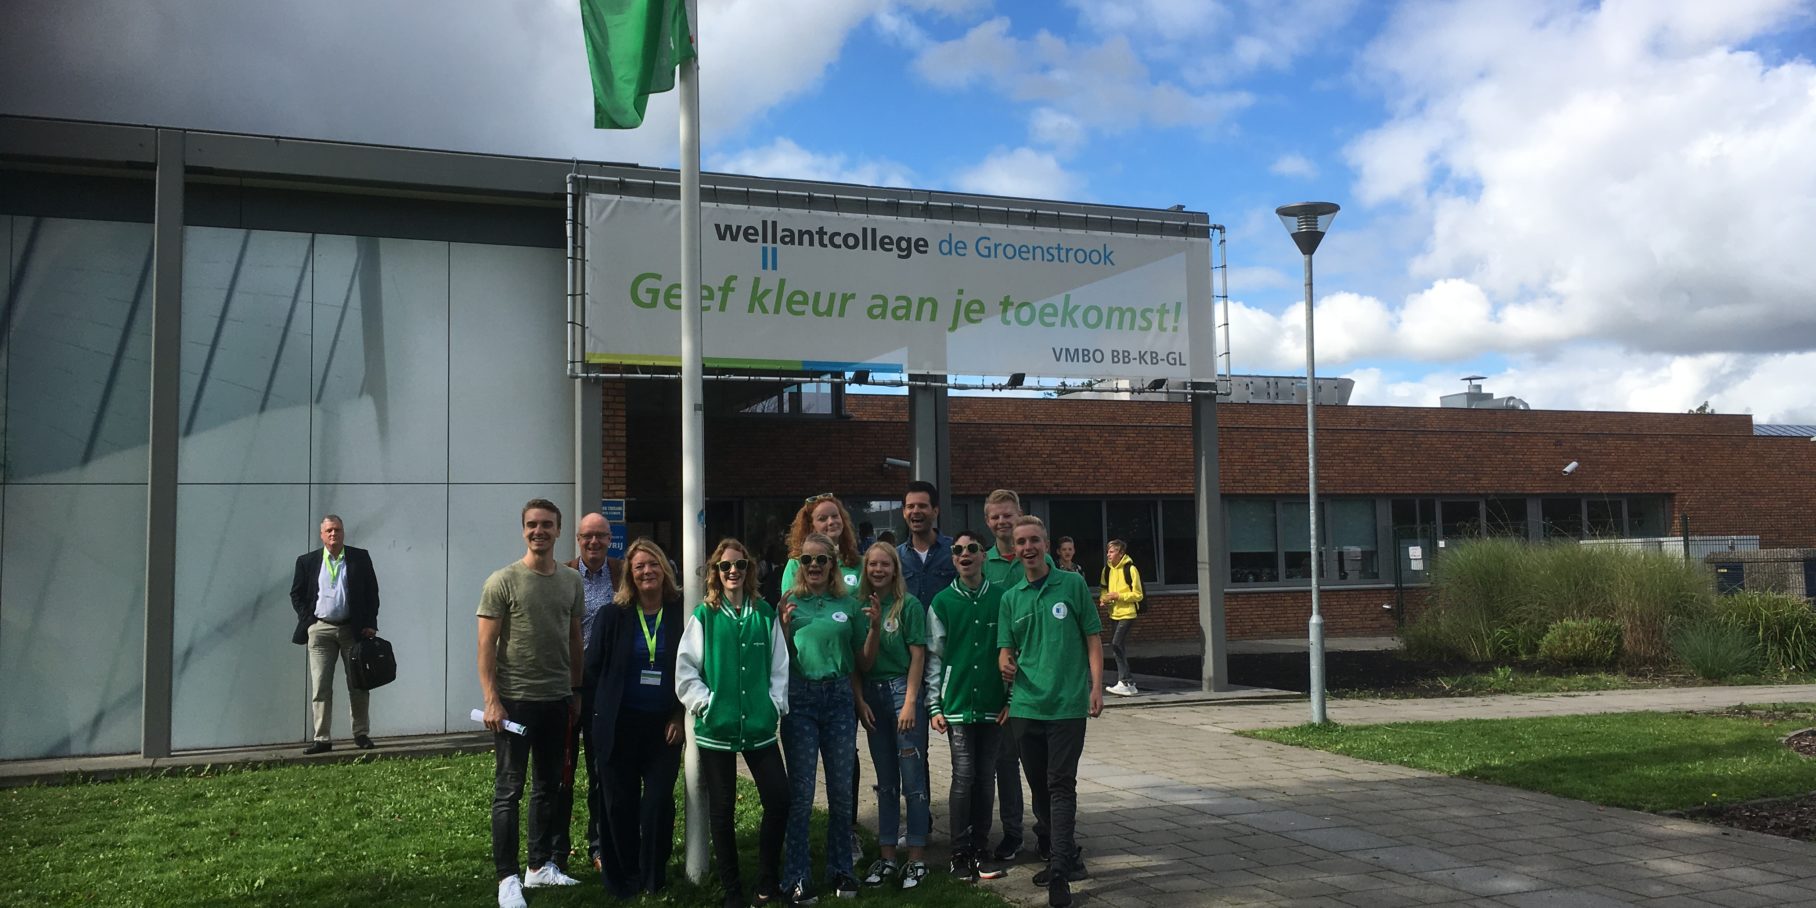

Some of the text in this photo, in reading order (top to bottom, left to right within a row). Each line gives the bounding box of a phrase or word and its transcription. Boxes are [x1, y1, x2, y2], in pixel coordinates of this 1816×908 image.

[714, 219, 1115, 266] wellantcollege de Groenstrook
[629, 272, 1182, 333] Geef kleur aan je toekomst!
[1051, 346, 1187, 367] VMBO BB-KB-GL
